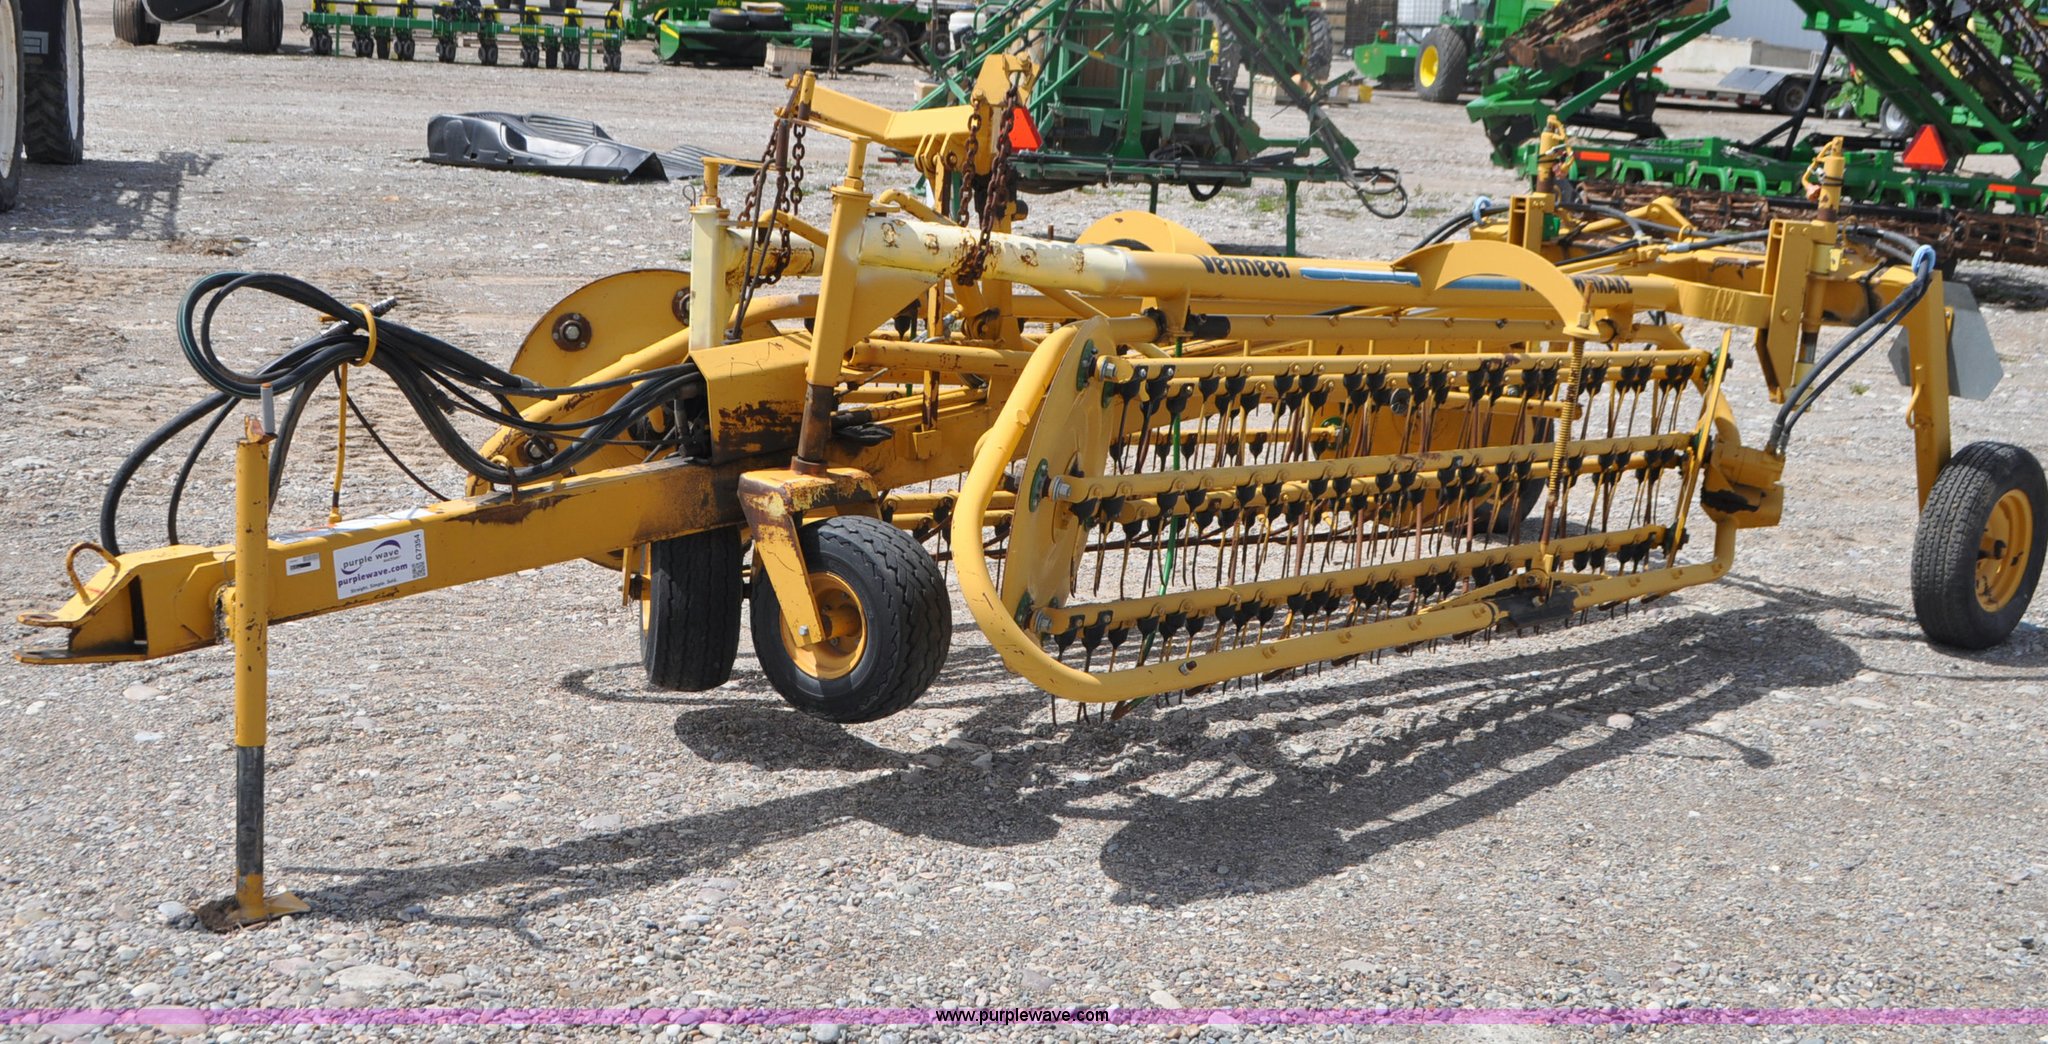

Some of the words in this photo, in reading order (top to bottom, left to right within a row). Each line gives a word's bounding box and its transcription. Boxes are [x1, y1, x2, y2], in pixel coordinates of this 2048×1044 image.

[805, 3, 827, 11] JOHN
[832, 4, 860, 13] DERE
[414, 533, 422, 560] G7354
[343, 555, 372, 569] purple
[375, 549, 399, 560] wave
[338, 563, 408, 588] purplewave.com
